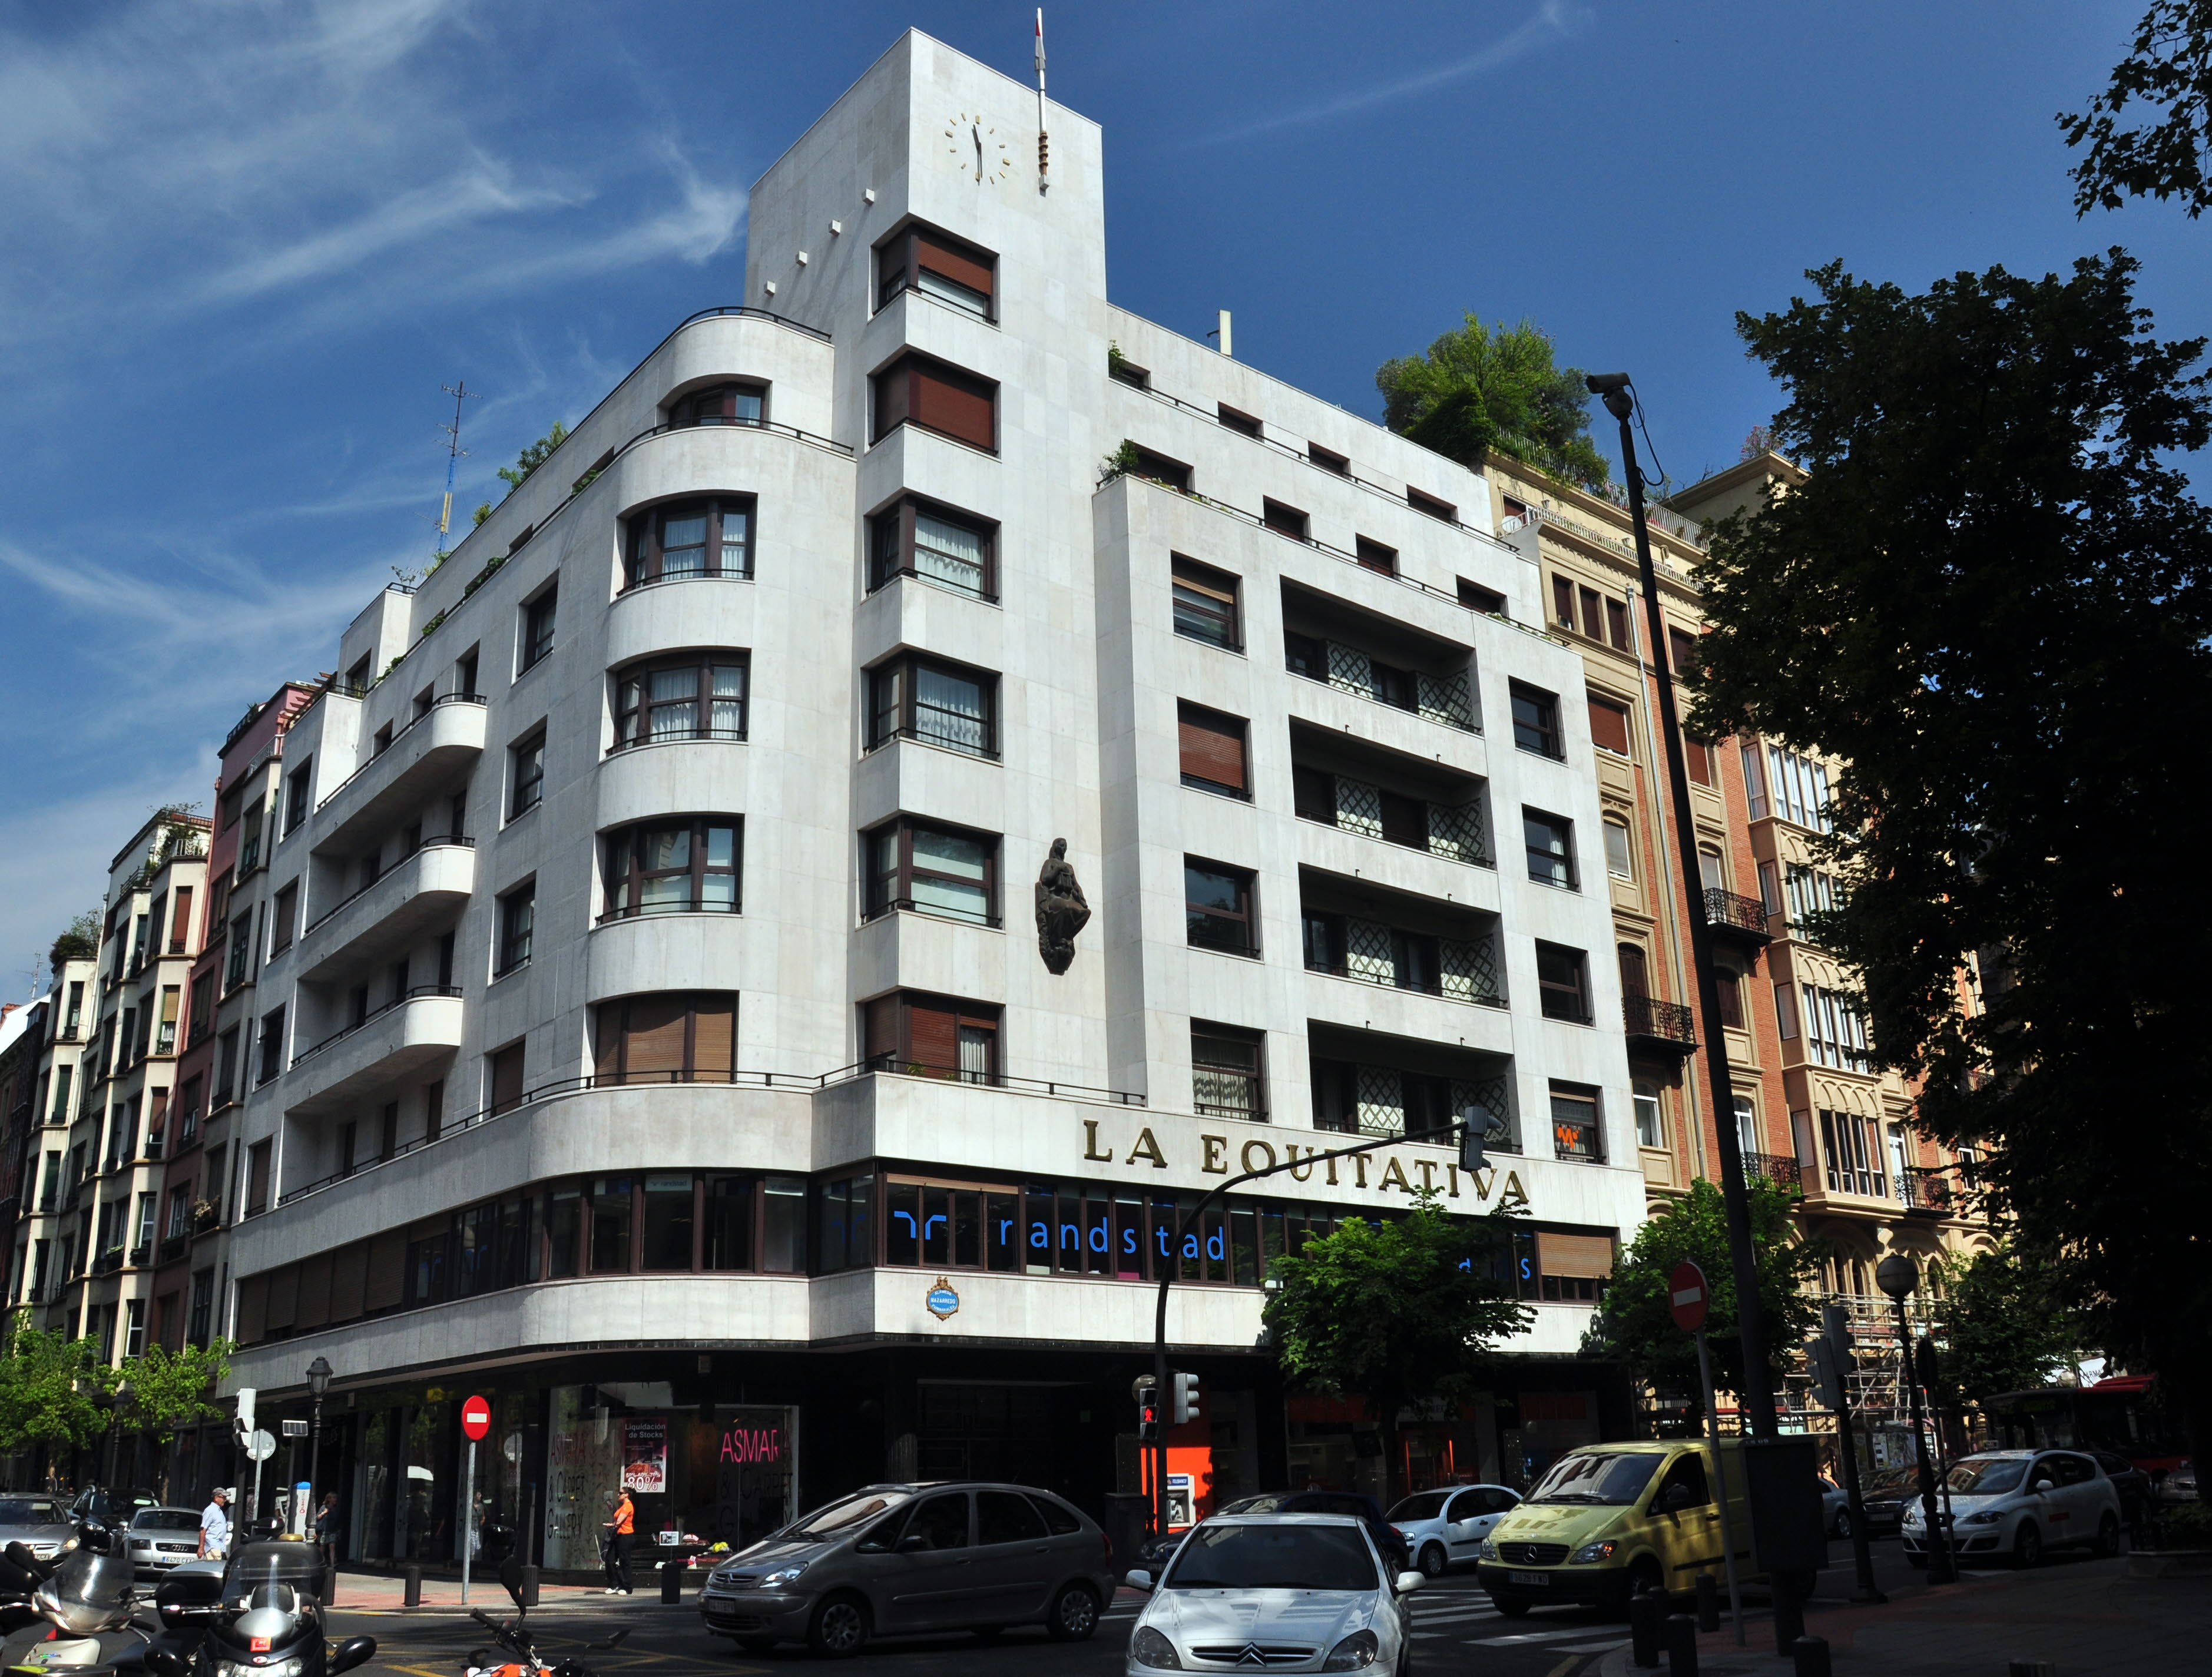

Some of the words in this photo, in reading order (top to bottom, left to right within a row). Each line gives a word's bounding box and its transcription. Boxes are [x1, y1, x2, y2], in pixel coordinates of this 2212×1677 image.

[1082, 1119, 1168, 1169] LA
[1200, 1134, 1530, 1205] EQUITATIVA
[1000, 1217, 1224, 1261] randstad
[625, 1423, 665, 1431] Liquidación
[627, 1476, 658, 1491] 80%
